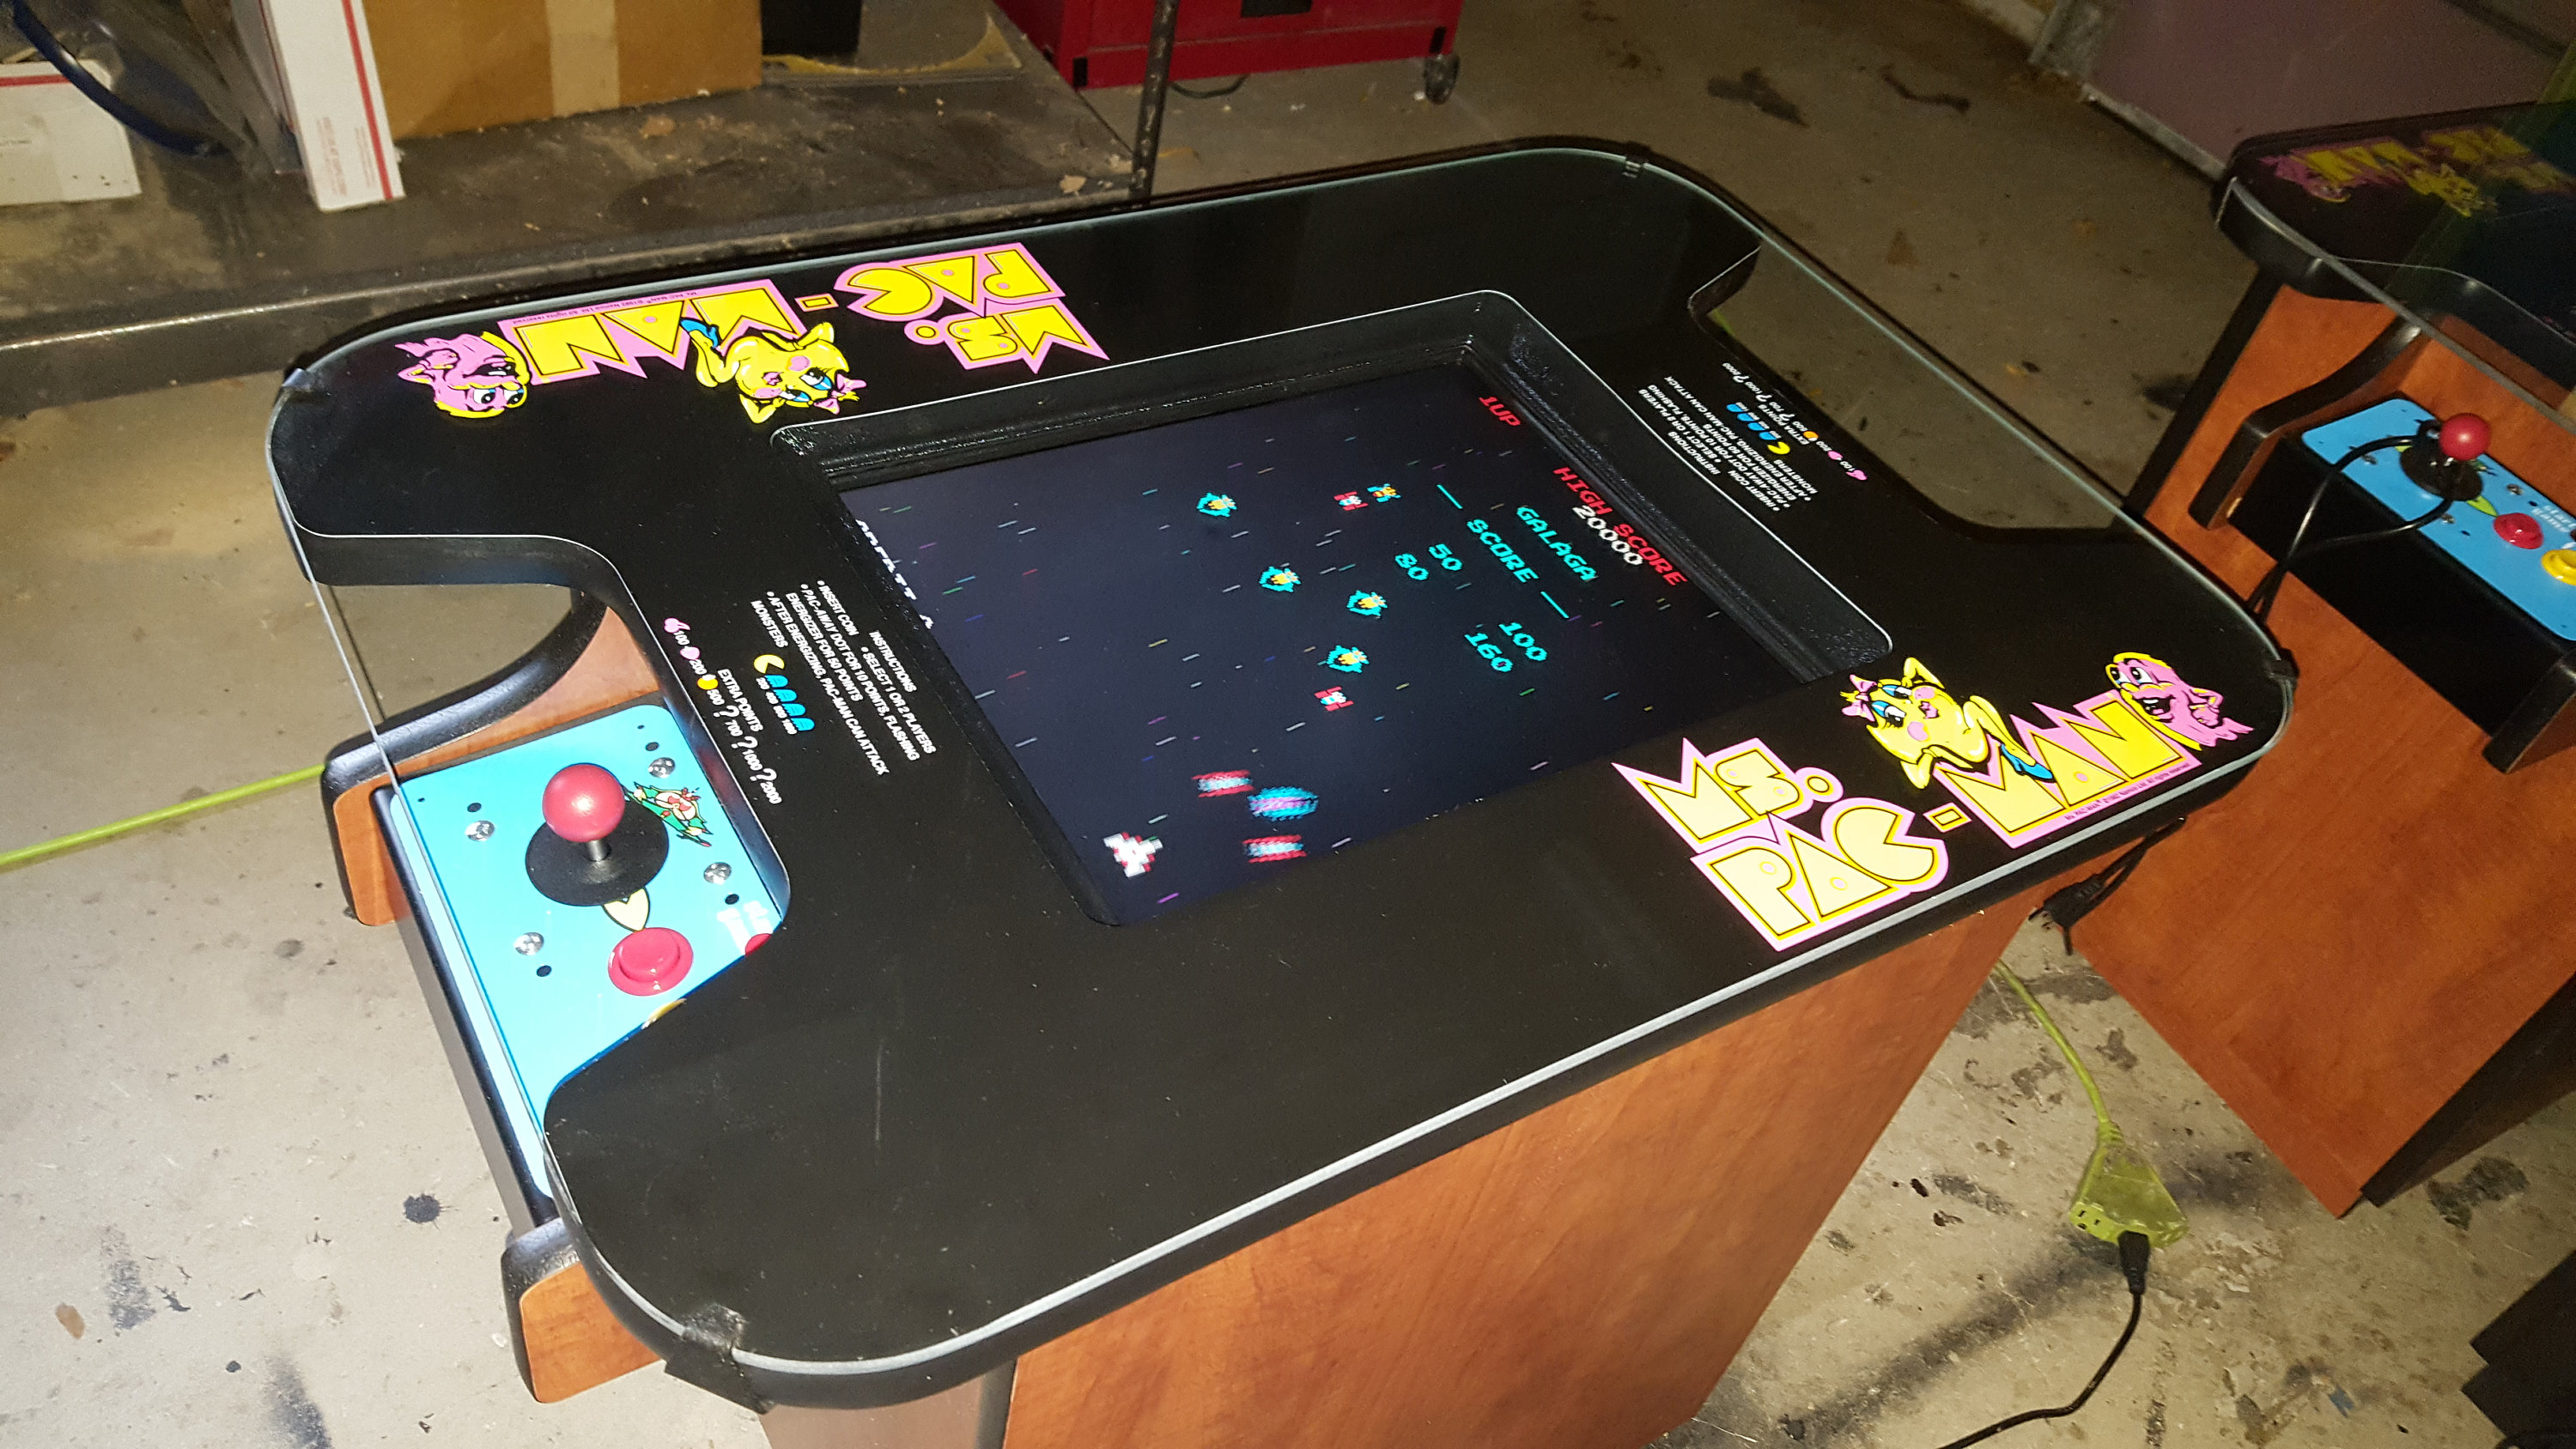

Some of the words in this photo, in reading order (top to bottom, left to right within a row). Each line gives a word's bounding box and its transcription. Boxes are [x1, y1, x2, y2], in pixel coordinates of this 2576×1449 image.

[1647, 384, 1684, 415] FLASHING
[1663, 375, 1695, 399] ATTACK
[1479, 397, 1522, 427] 1UP
[1637, 388, 1672, 417] PLAYERS
[1689, 398, 1708, 413] CAN
[1757, 403, 1788, 427] POINTS
[1671, 420, 1686, 432] OR
[1680, 413, 1710, 440] POINTS,
[1702, 423, 1733, 447] POINTS
[1703, 411, 1739, 440] PAC-MAN
[1783, 425, 1810, 446] EXTRA
[1667, 431, 1722, 475] INSTRUCTIONS
[1686, 435, 1718, 459] SELECT
[1704, 437, 1717, 446] 10
[1712, 445, 1734, 459] FOR
[1727, 445, 1741, 454] 50
[1727, 458, 1748, 472] DOT
[1735, 438, 1784, 477] ENERGIZING,
[1735, 452, 1757, 467] FOR
[1727, 470, 1751, 486] COIN
[1742, 471, 1788, 504] PAC-AWAY
[1751, 465, 1797, 500] ENERGIZER
[1772, 458, 1819, 494] MONSTERS
[1778, 476, 1808, 497] AFTER
[1745, 485, 1777, 507] INSERT
[1552, 466, 1613, 515] HIGH
[1613, 523, 1688, 586] SCORE
[1572, 505, 1643, 566] 20000
[1428, 543, 1463, 573] 50
[1467, 518, 1539, 584] SCORE
[1516, 506, 1598, 583] GALAGA
[1394, 553, 1430, 581] 80
[750, 599, 789, 648] MONSTERS
[785, 591, 824, 640] ENERGIZER
[800, 589, 839, 633] PAC-AWAY
[817, 585, 847, 614] INSERT
[836, 614, 860, 636] COIN
[815, 638, 836, 658] FOR
[829, 633, 851, 652] DOT
[1464, 632, 1513, 673] 160
[1499, 621, 1548, 663] 100
[826, 657, 842, 670] 50
[841, 651, 862, 671] FOR
[854, 670, 869, 682] 10
[868, 630, 917, 693] INSTRUCTIONS
[767, 597, 794, 625] AFTER
[784, 622, 827, 679] ENERGIZING,
[819, 677, 854, 719] PAC-MAN
[845, 718, 867, 739] CAN
[856, 738, 890, 775] ATTACK
[833, 667, 864, 701] POINTS
[860, 680, 890, 717] POINTS,
[716, 668, 744, 700] EXTRA
[733, 696, 764, 732] POINTS
[862, 652, 893, 686] SELECT
[888, 692, 907, 707] OR
[901, 712, 937, 754] PLAYERS
[672, 630, 690, 646] 100
[688, 658, 708, 676] 200
[706, 688, 726, 706] 500
[724, 718, 744, 737] 700
[741, 749, 763, 771] 1000
[759, 780, 782, 804] 2000
[883, 714, 920, 761] FLASHING
